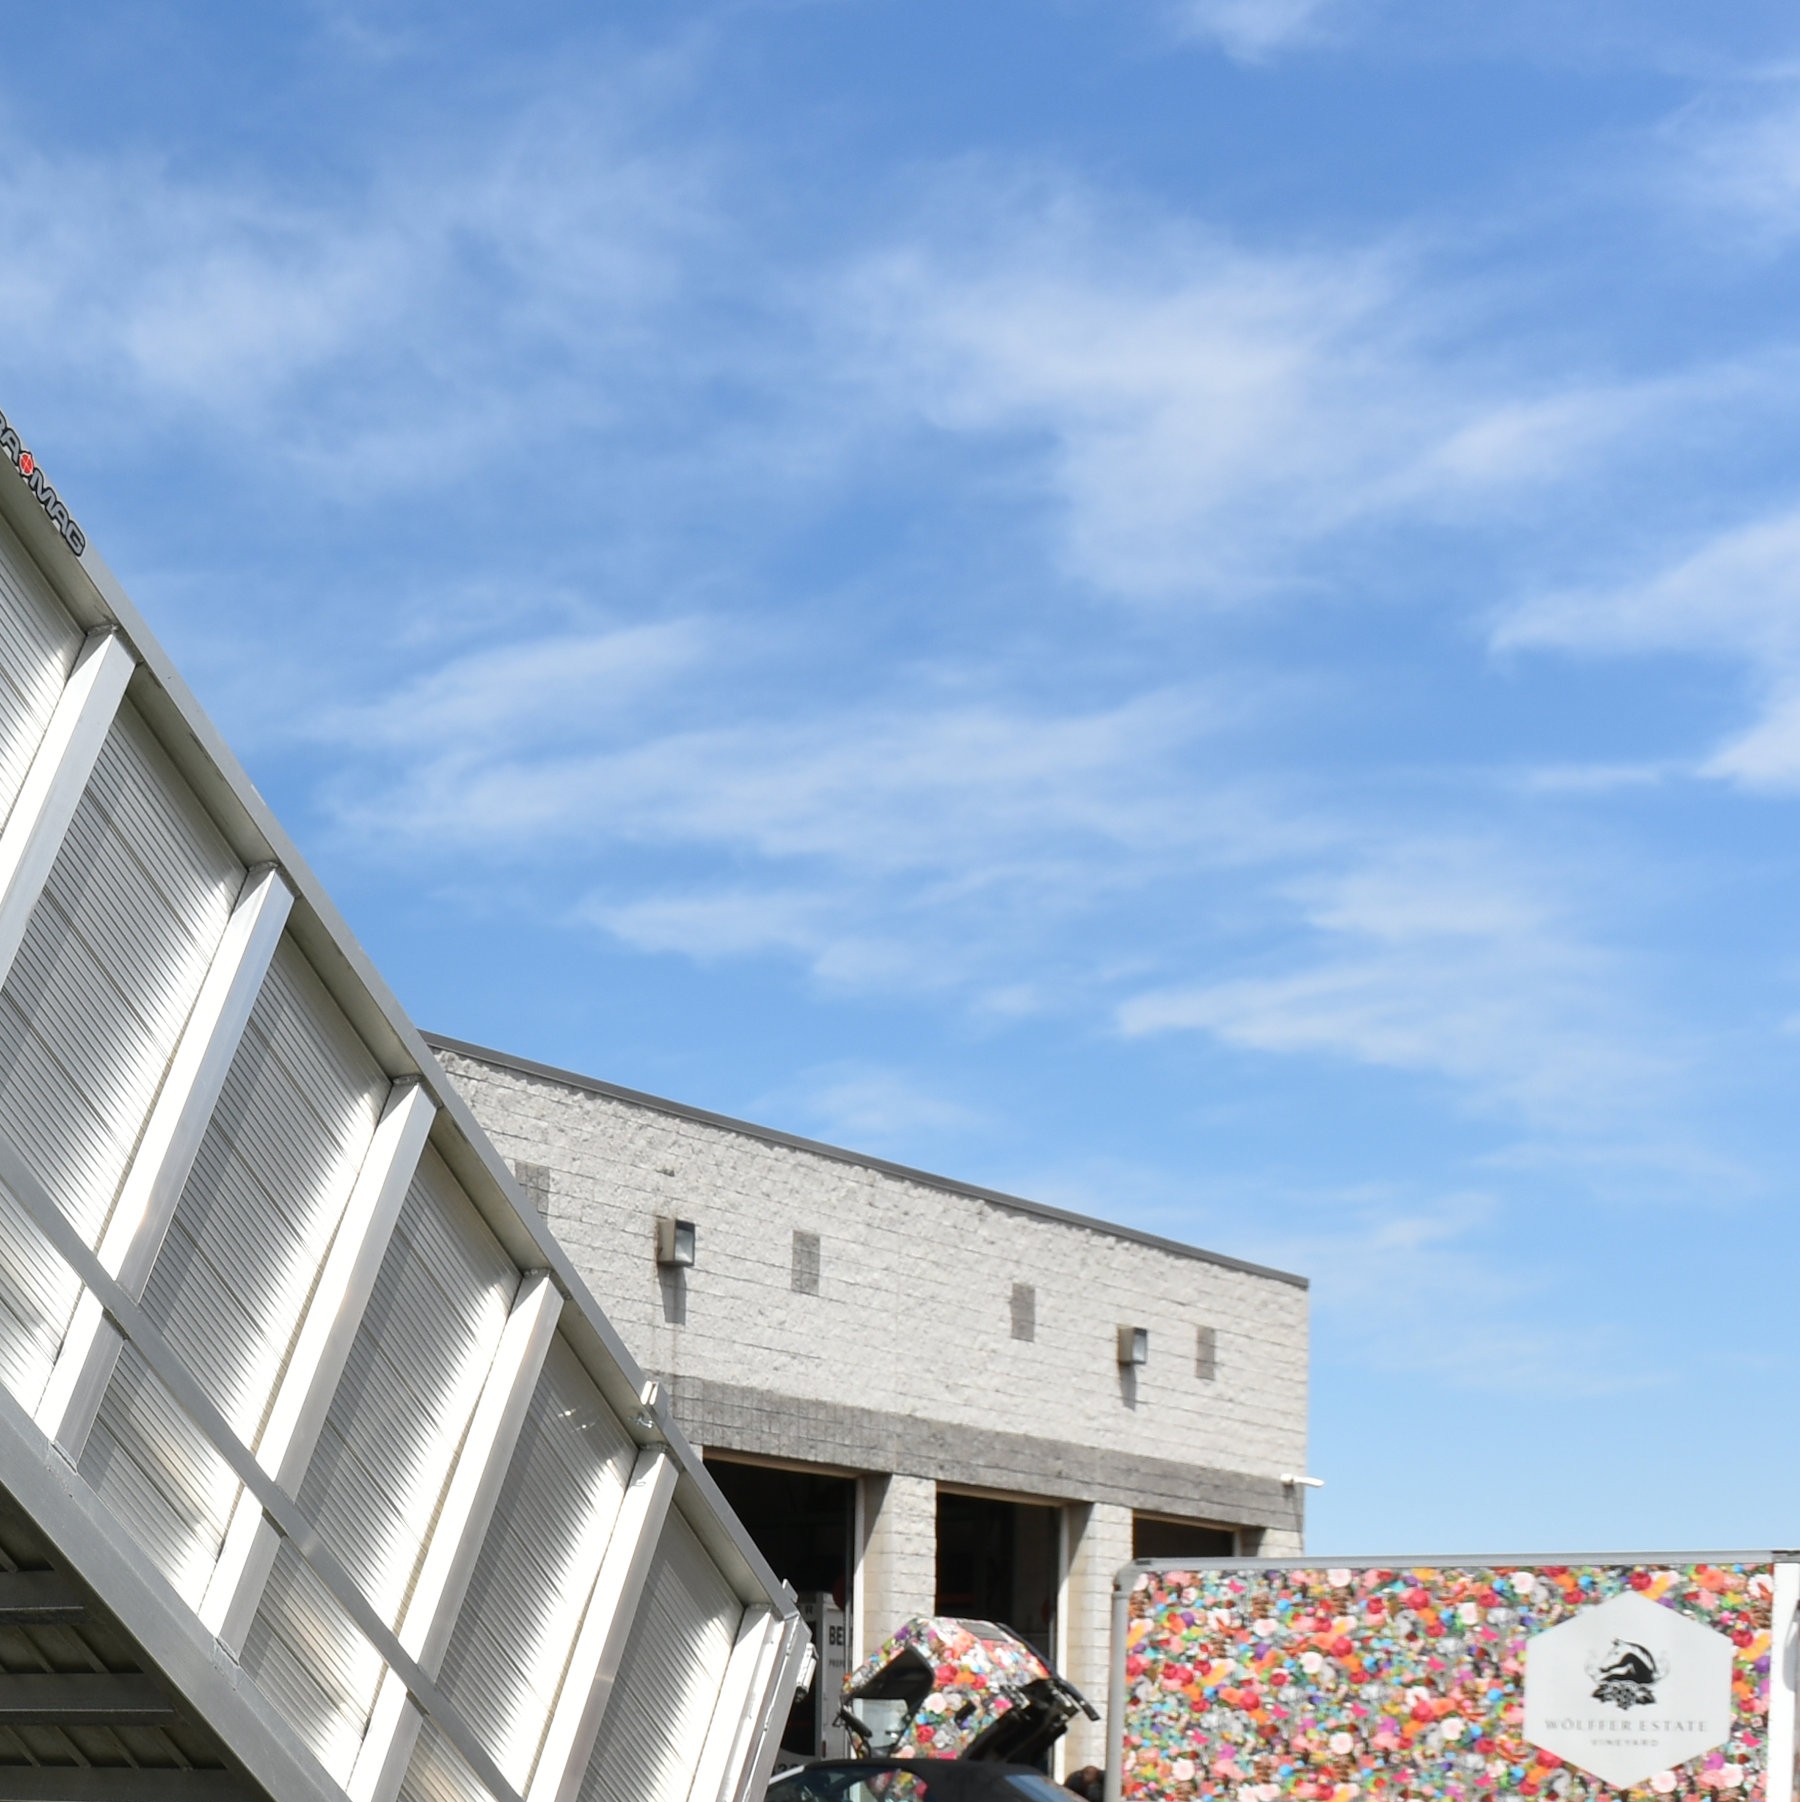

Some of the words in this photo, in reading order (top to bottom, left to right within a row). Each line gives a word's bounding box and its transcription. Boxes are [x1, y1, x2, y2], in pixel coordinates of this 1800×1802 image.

[1546, 1717, 1632, 1732] WÖLFFER
[1639, 1719, 1708, 1732] ESTATE
[1591, 1738, 1660, 1747] VINEYARD
